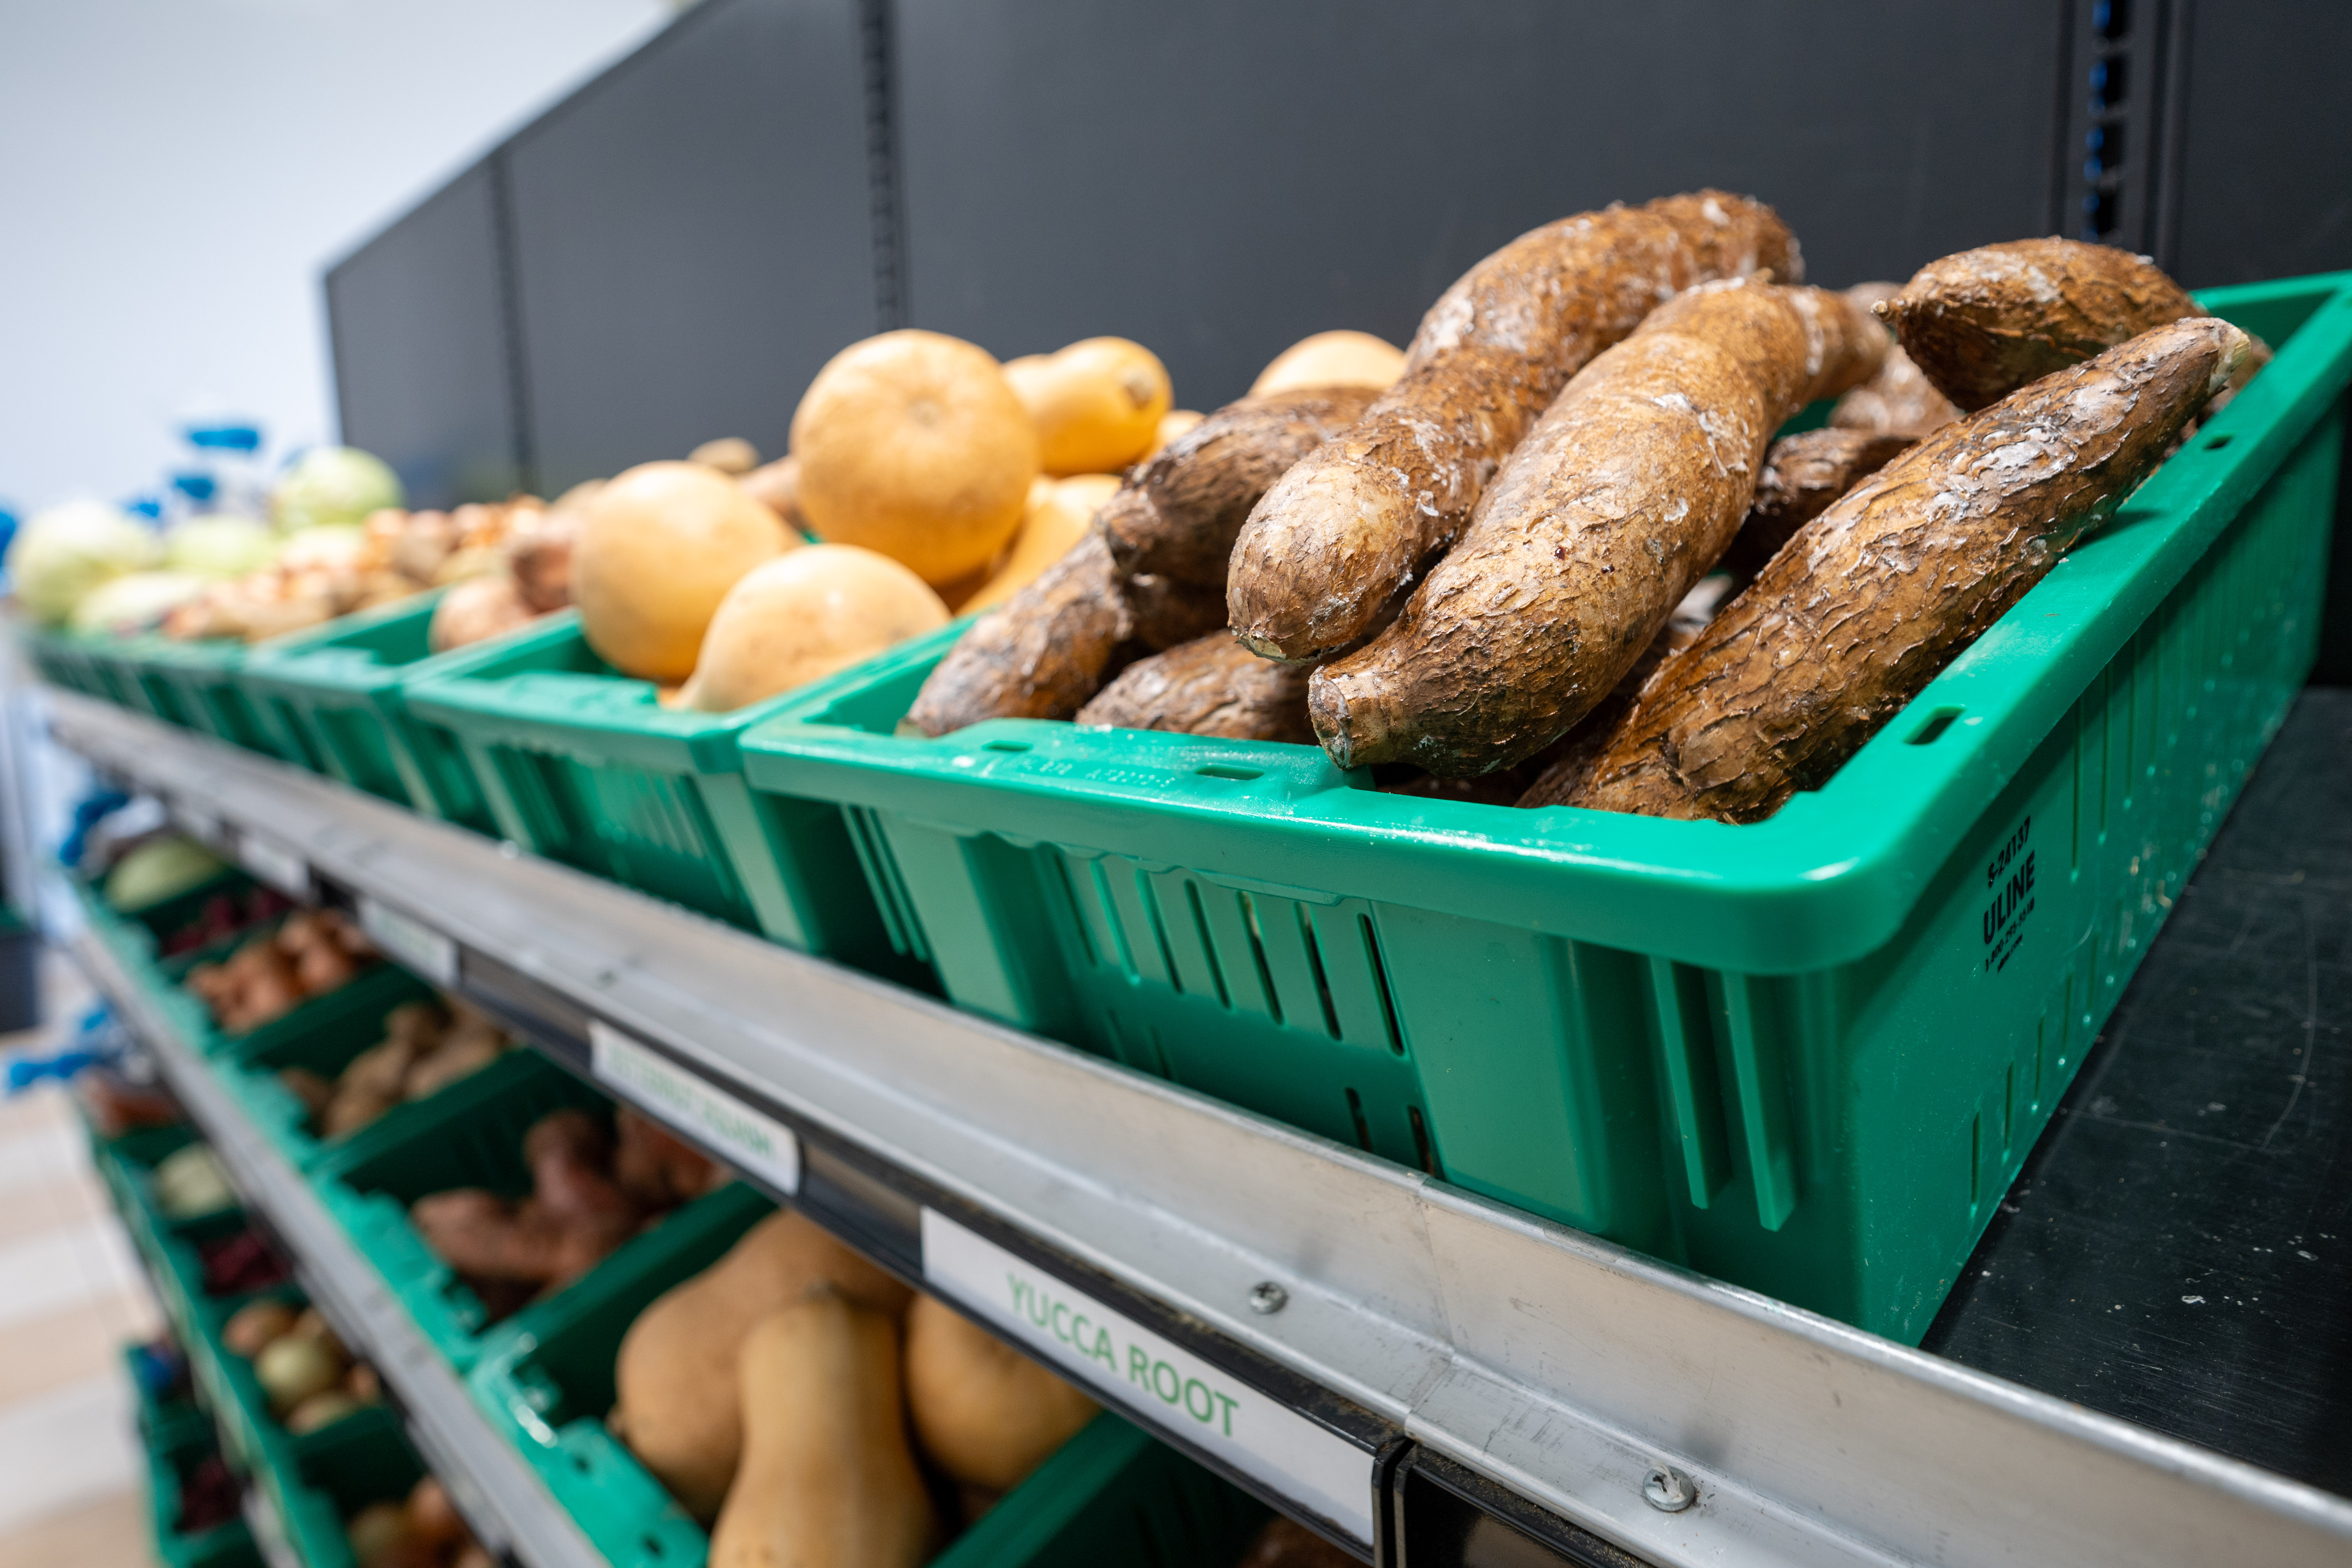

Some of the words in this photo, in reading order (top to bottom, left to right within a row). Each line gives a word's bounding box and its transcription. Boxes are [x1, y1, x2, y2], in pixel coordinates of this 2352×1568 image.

[1984, 849, 2035, 944] ULINE
[1988, 815, 2030, 888] S-24137
[1007, 1273, 1118, 1372] YUCCA
[1127, 1344, 1240, 1438] ROOT
